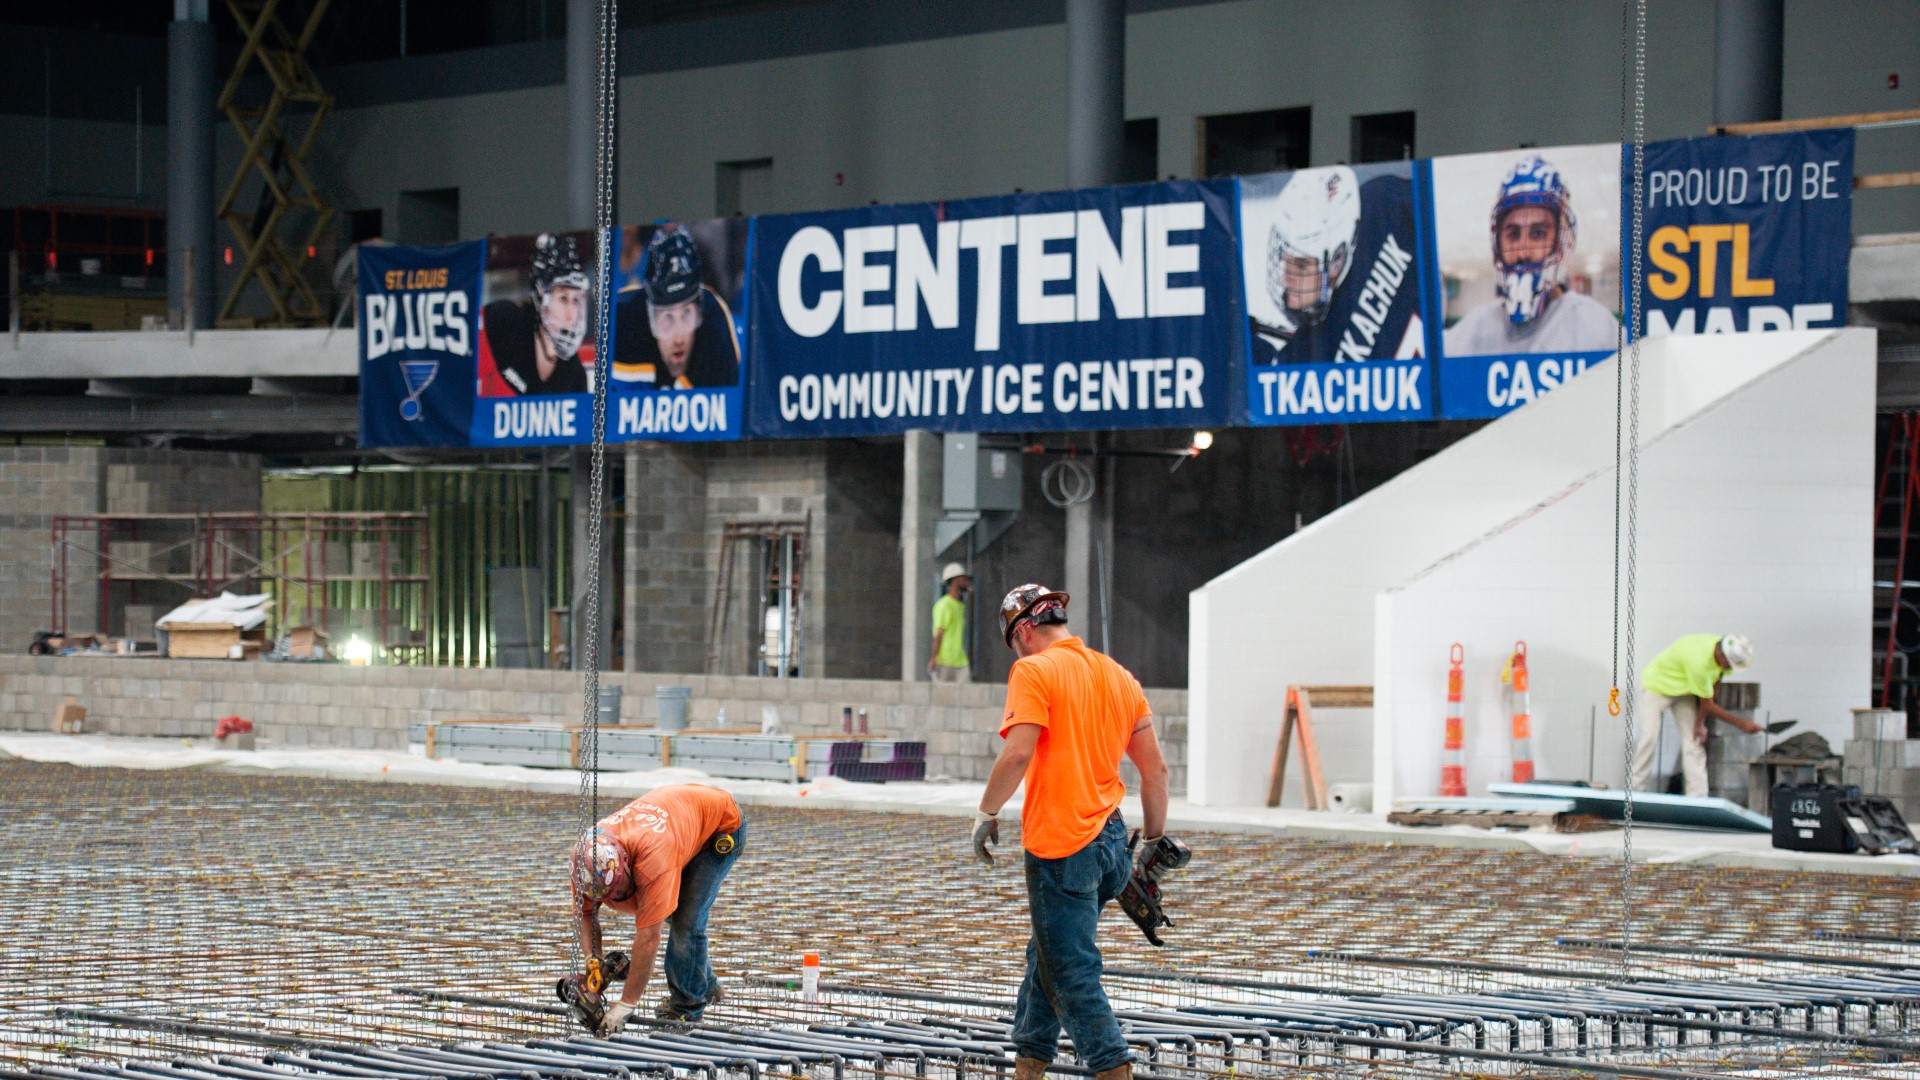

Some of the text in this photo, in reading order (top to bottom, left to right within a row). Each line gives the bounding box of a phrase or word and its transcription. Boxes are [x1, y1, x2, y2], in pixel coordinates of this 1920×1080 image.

[1649, 160, 1841, 208] PROUD TO BE
[407, 268, 449, 290] LOUIS
[778, 202, 1206, 351] CENTENE
[1647, 223, 1775, 300] STL
[365, 290, 469, 361] BLUES
[618, 393, 727, 434] MAROON
[779, 357, 1205, 421] COMMUNITY ICE CENTER
[1258, 365, 1422, 415] TKACHUK
[494, 400, 577, 438] DUNNE
